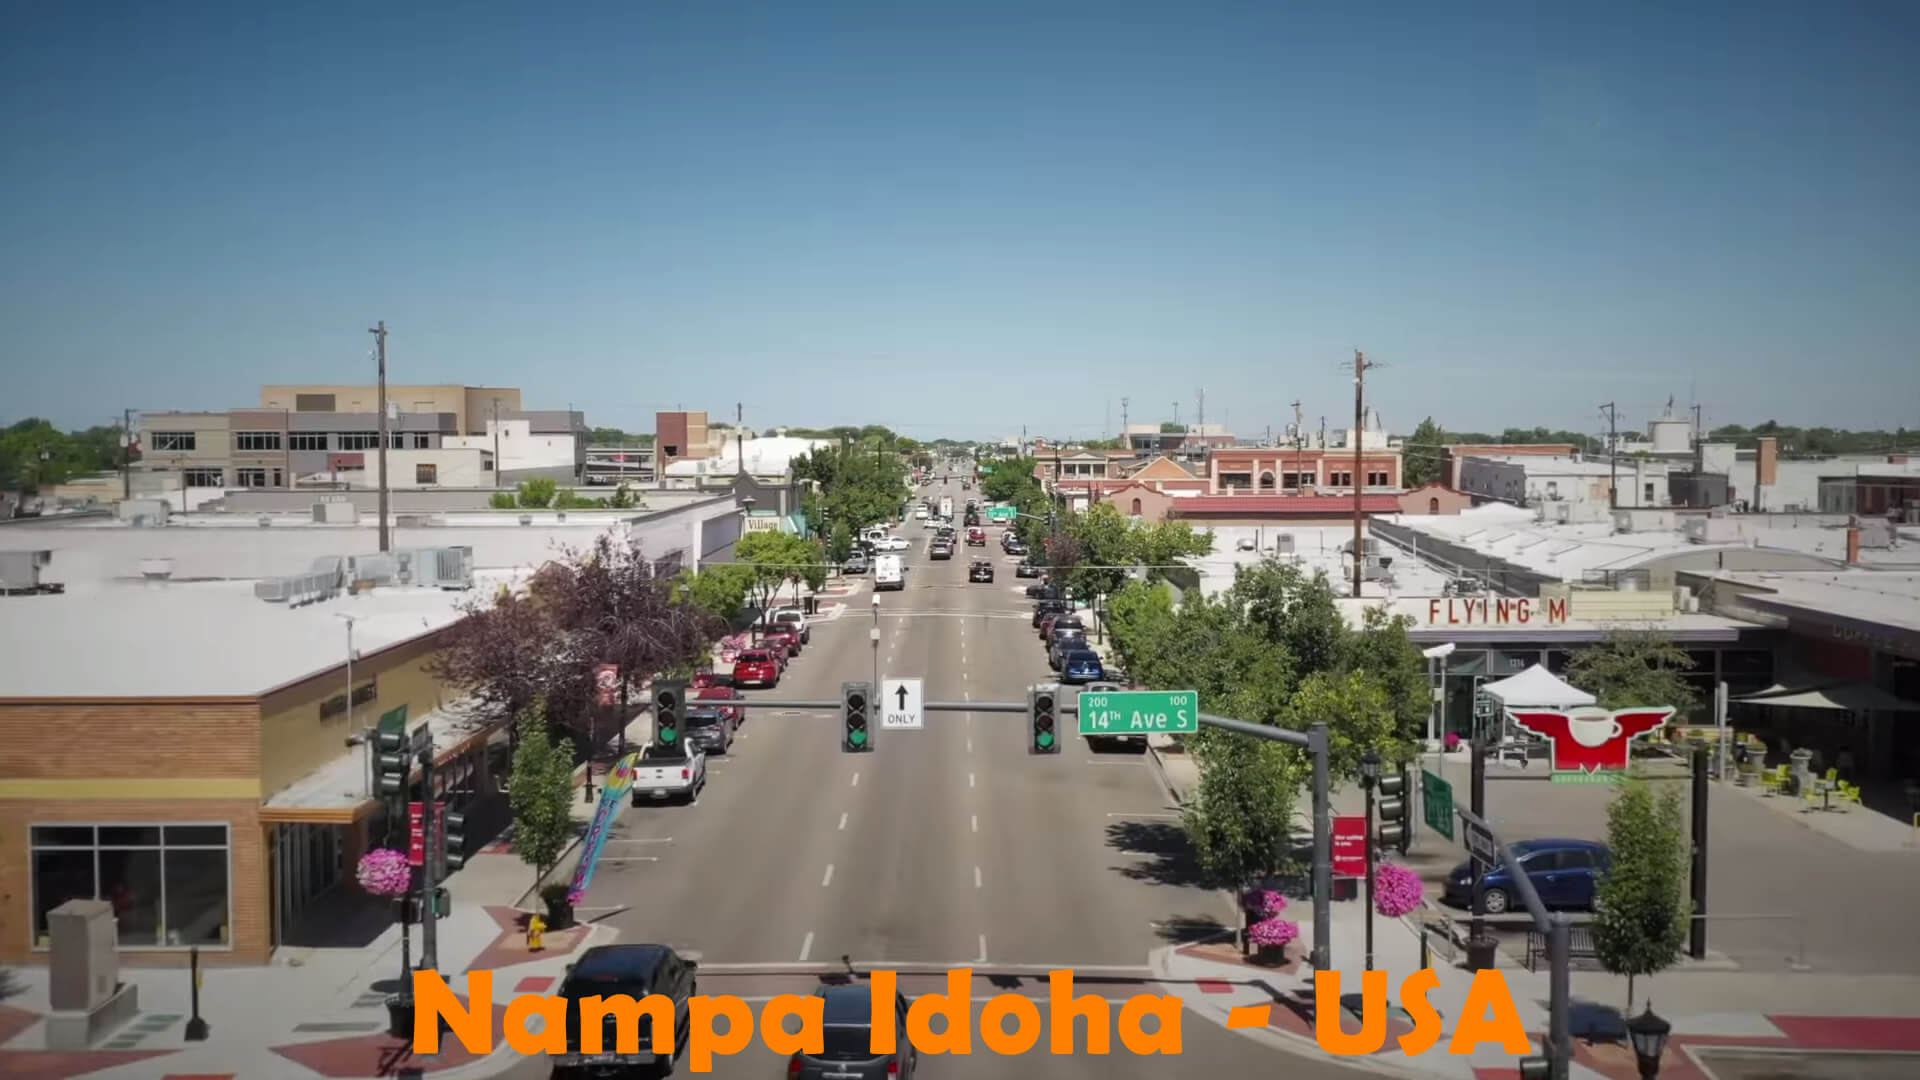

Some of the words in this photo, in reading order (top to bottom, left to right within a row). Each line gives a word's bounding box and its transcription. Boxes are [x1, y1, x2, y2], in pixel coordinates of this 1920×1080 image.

[1429, 599, 1530, 624] FLYING
[1548, 599, 1567, 624] M
[1088, 697, 1108, 707] 200
[1169, 695, 1187, 706] 100
[888, 714, 915, 724] ONLY
[1130, 711, 1167, 729] Ave
[1177, 709, 1188, 728] S
